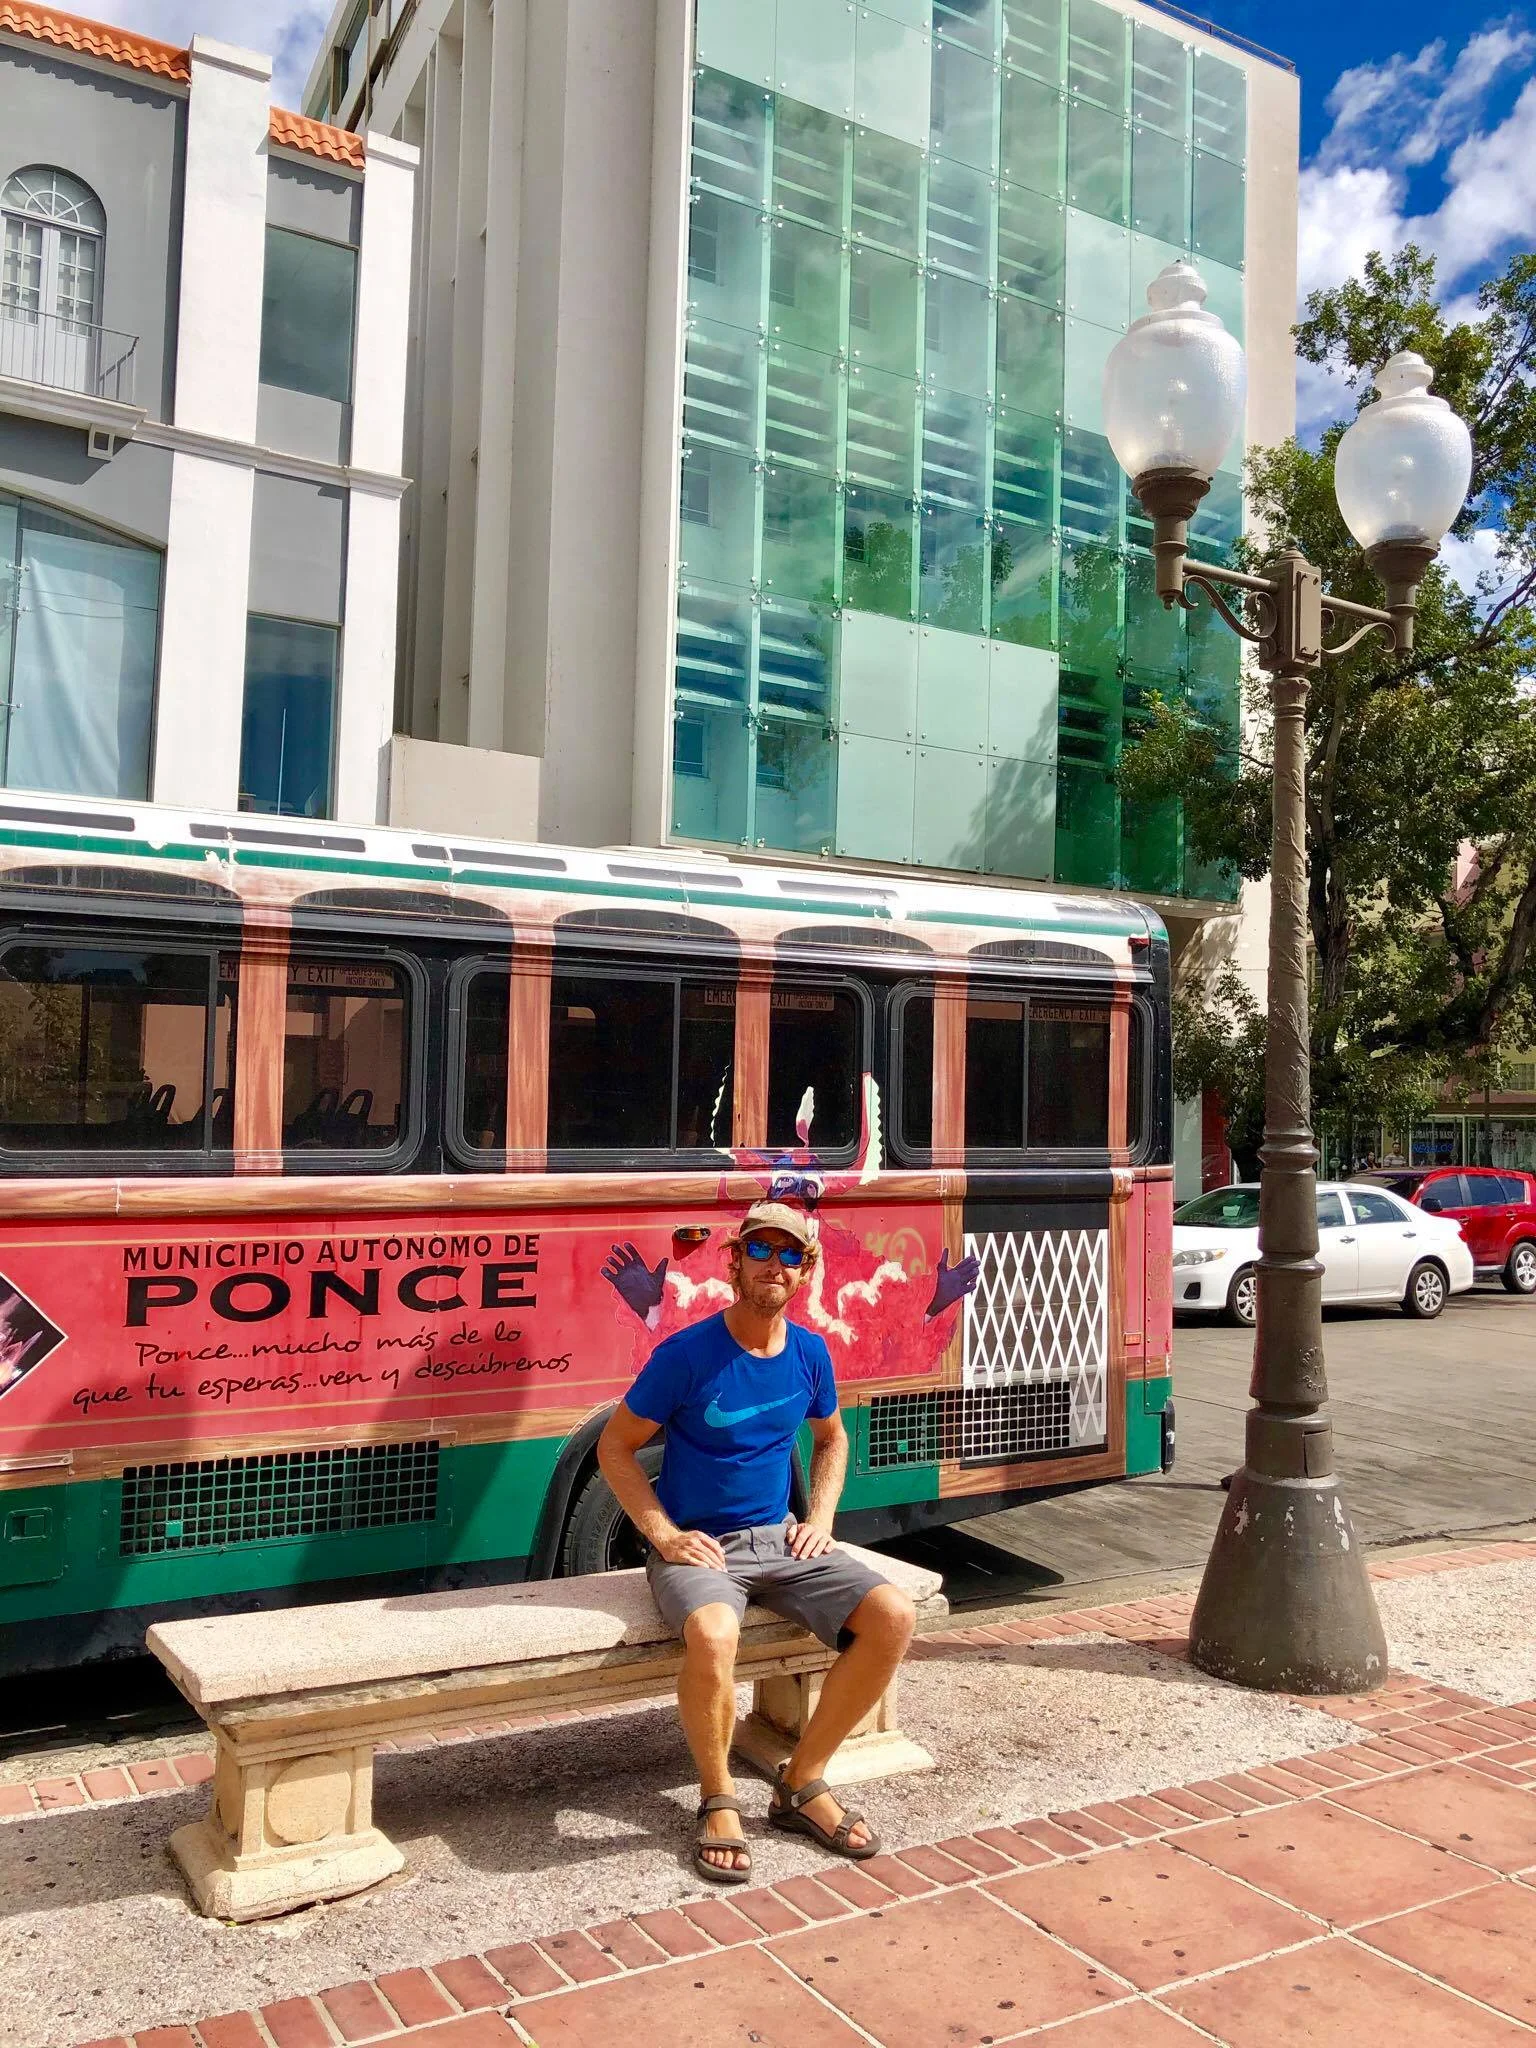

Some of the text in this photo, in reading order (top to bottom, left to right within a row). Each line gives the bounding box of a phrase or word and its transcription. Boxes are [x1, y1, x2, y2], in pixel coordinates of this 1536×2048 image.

[307, 966, 337, 983] EXIT
[368, 977, 386, 987] ONLY
[1079, 1009, 1097, 1021] EXIT
[123, 1234, 540, 1272] MUNICIPIO AUTÓNOMO DE
[123, 1259, 538, 1328] PONCE
[377, 1326, 438, 1351] más
[450, 1321, 482, 1345] de
[495, 1321, 522, 1342] lo
[73, 1386, 133, 1414] que
[145, 1372, 184, 1399] tu
[381, 1368, 400, 1390] y
[415, 1351, 573, 1381] descúbrenos
